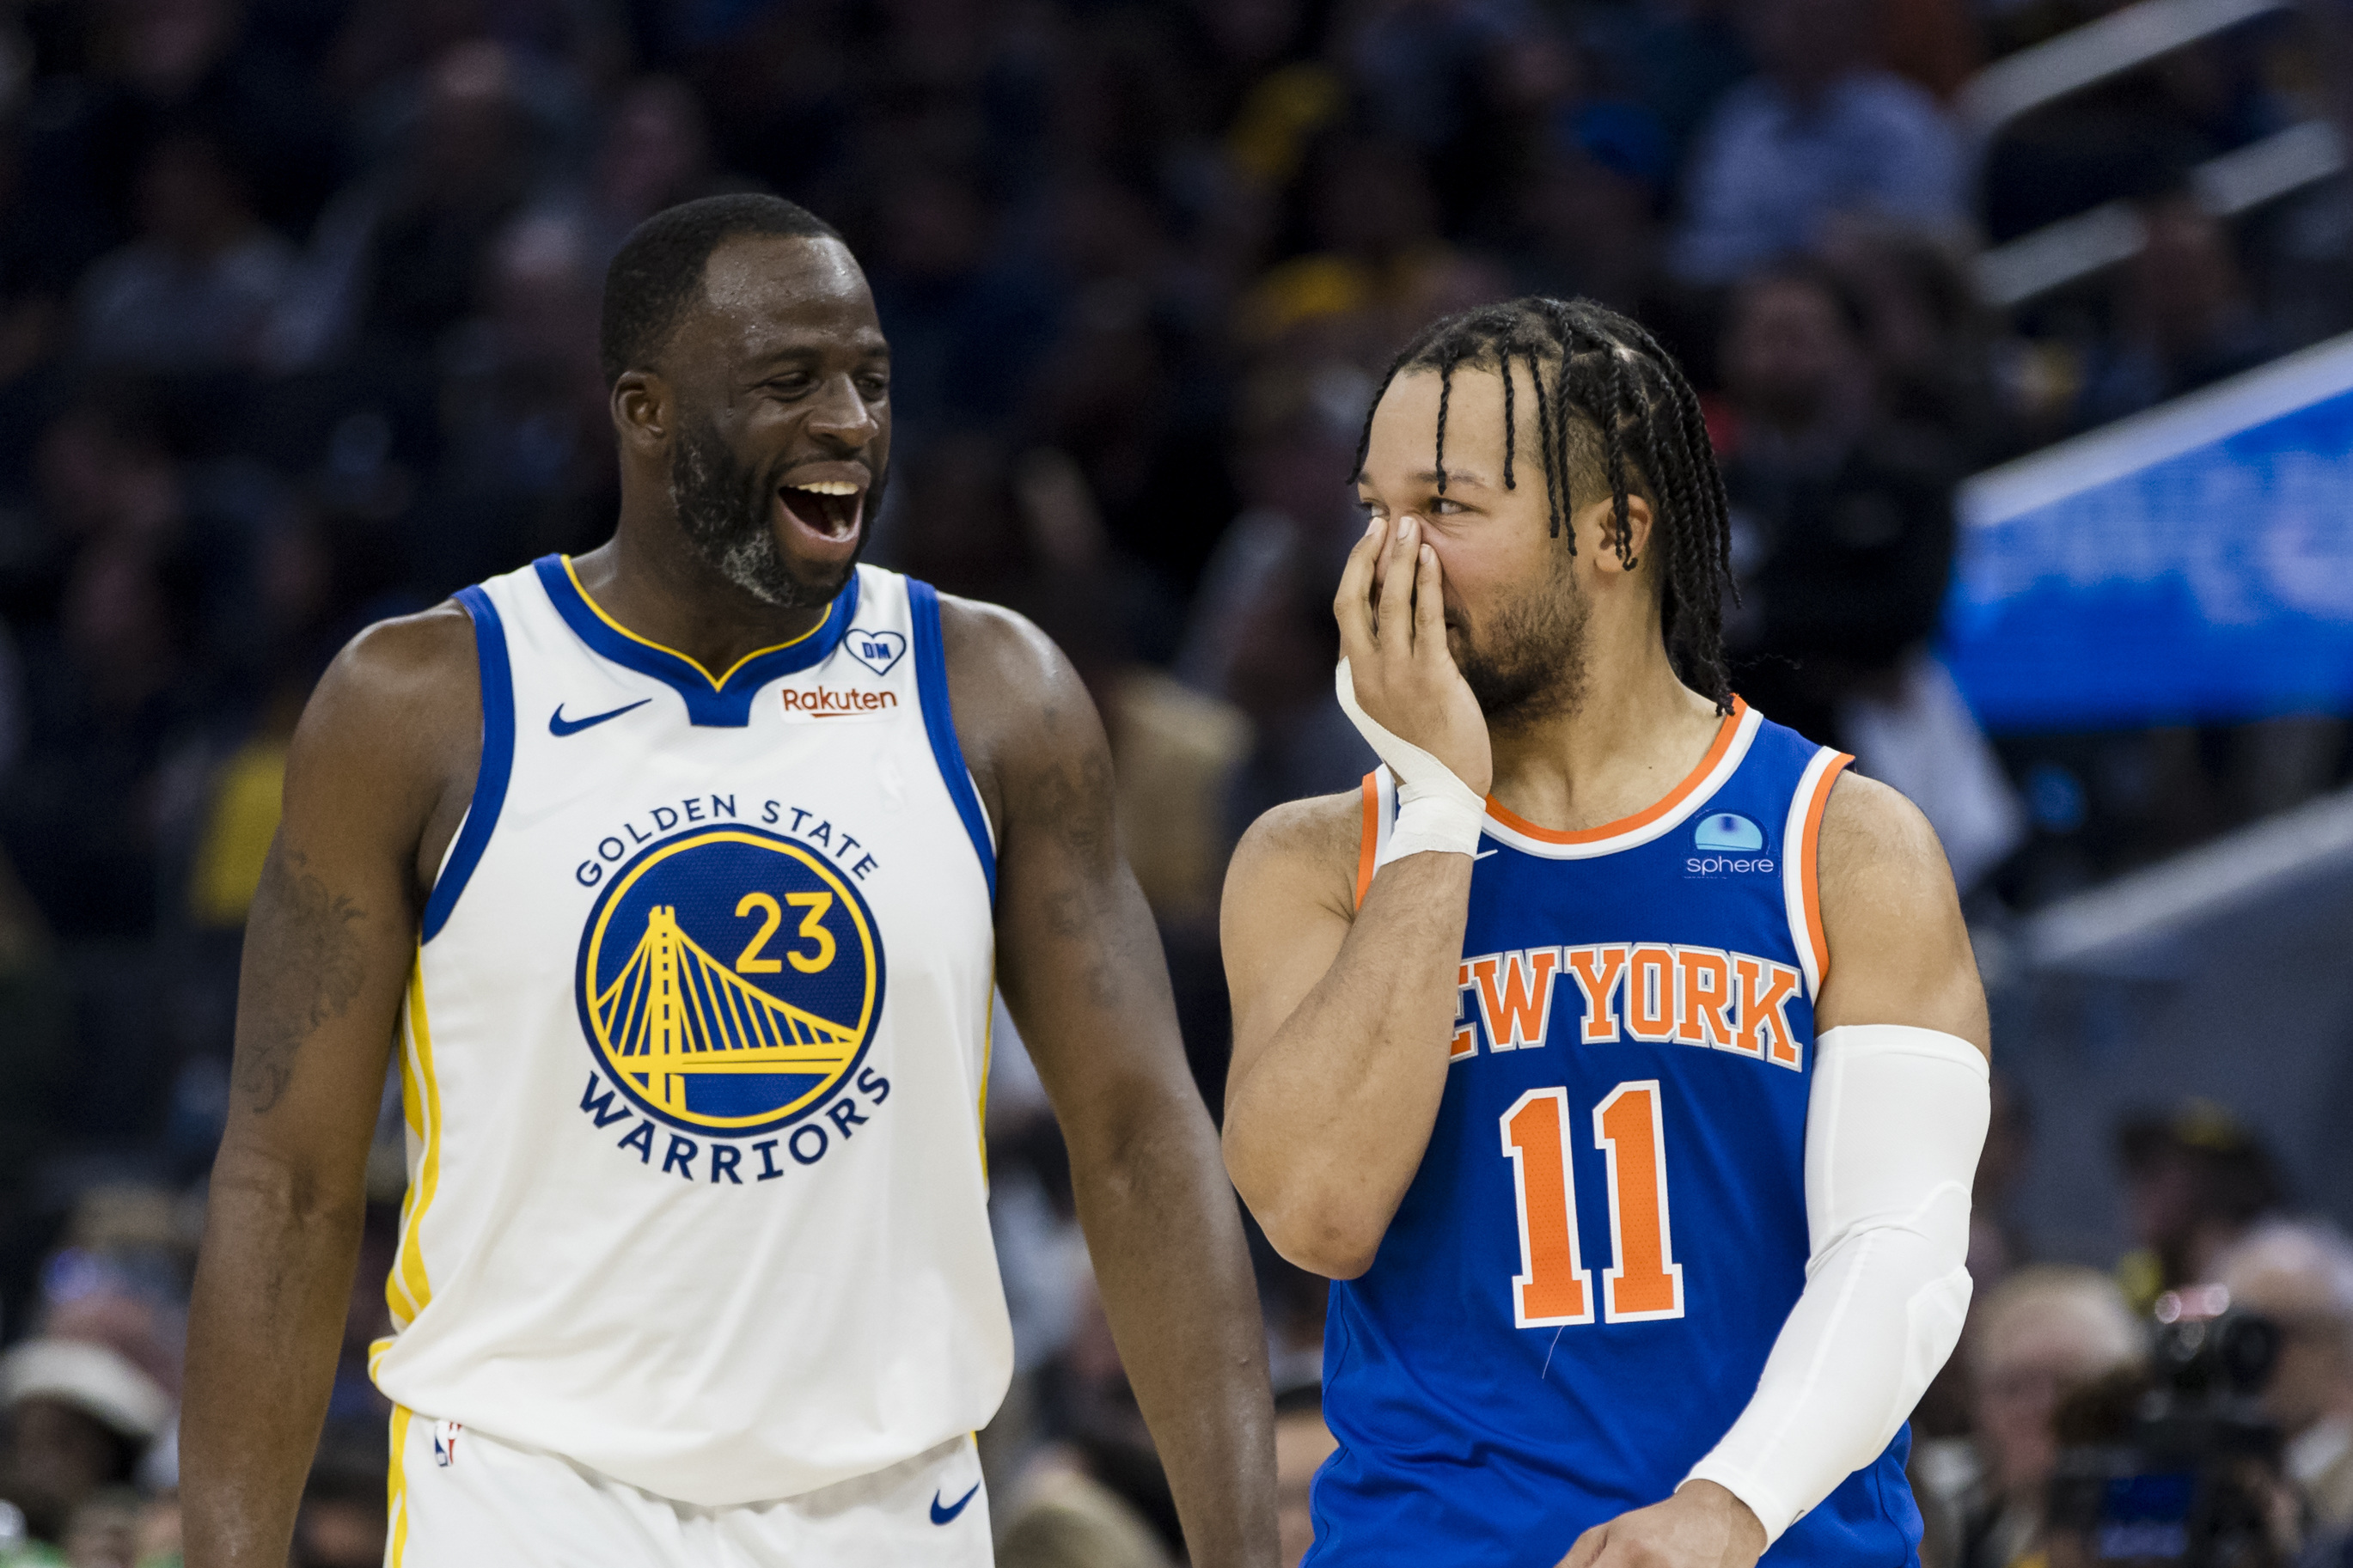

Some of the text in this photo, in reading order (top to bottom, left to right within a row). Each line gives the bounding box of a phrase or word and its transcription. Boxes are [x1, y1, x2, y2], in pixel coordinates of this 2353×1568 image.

[862, 642, 891, 659] DM
[782, 686, 898, 711] Rakuten
[576, 794, 879, 888] GOLDEN STATE
[1686, 856, 1774, 876] sphere
[735, 892, 836, 973] 23
[1450, 942, 1803, 1072] EW YORK
[579, 1066, 891, 1185] WARRIORS
[1500, 1079, 1684, 1329] 11
